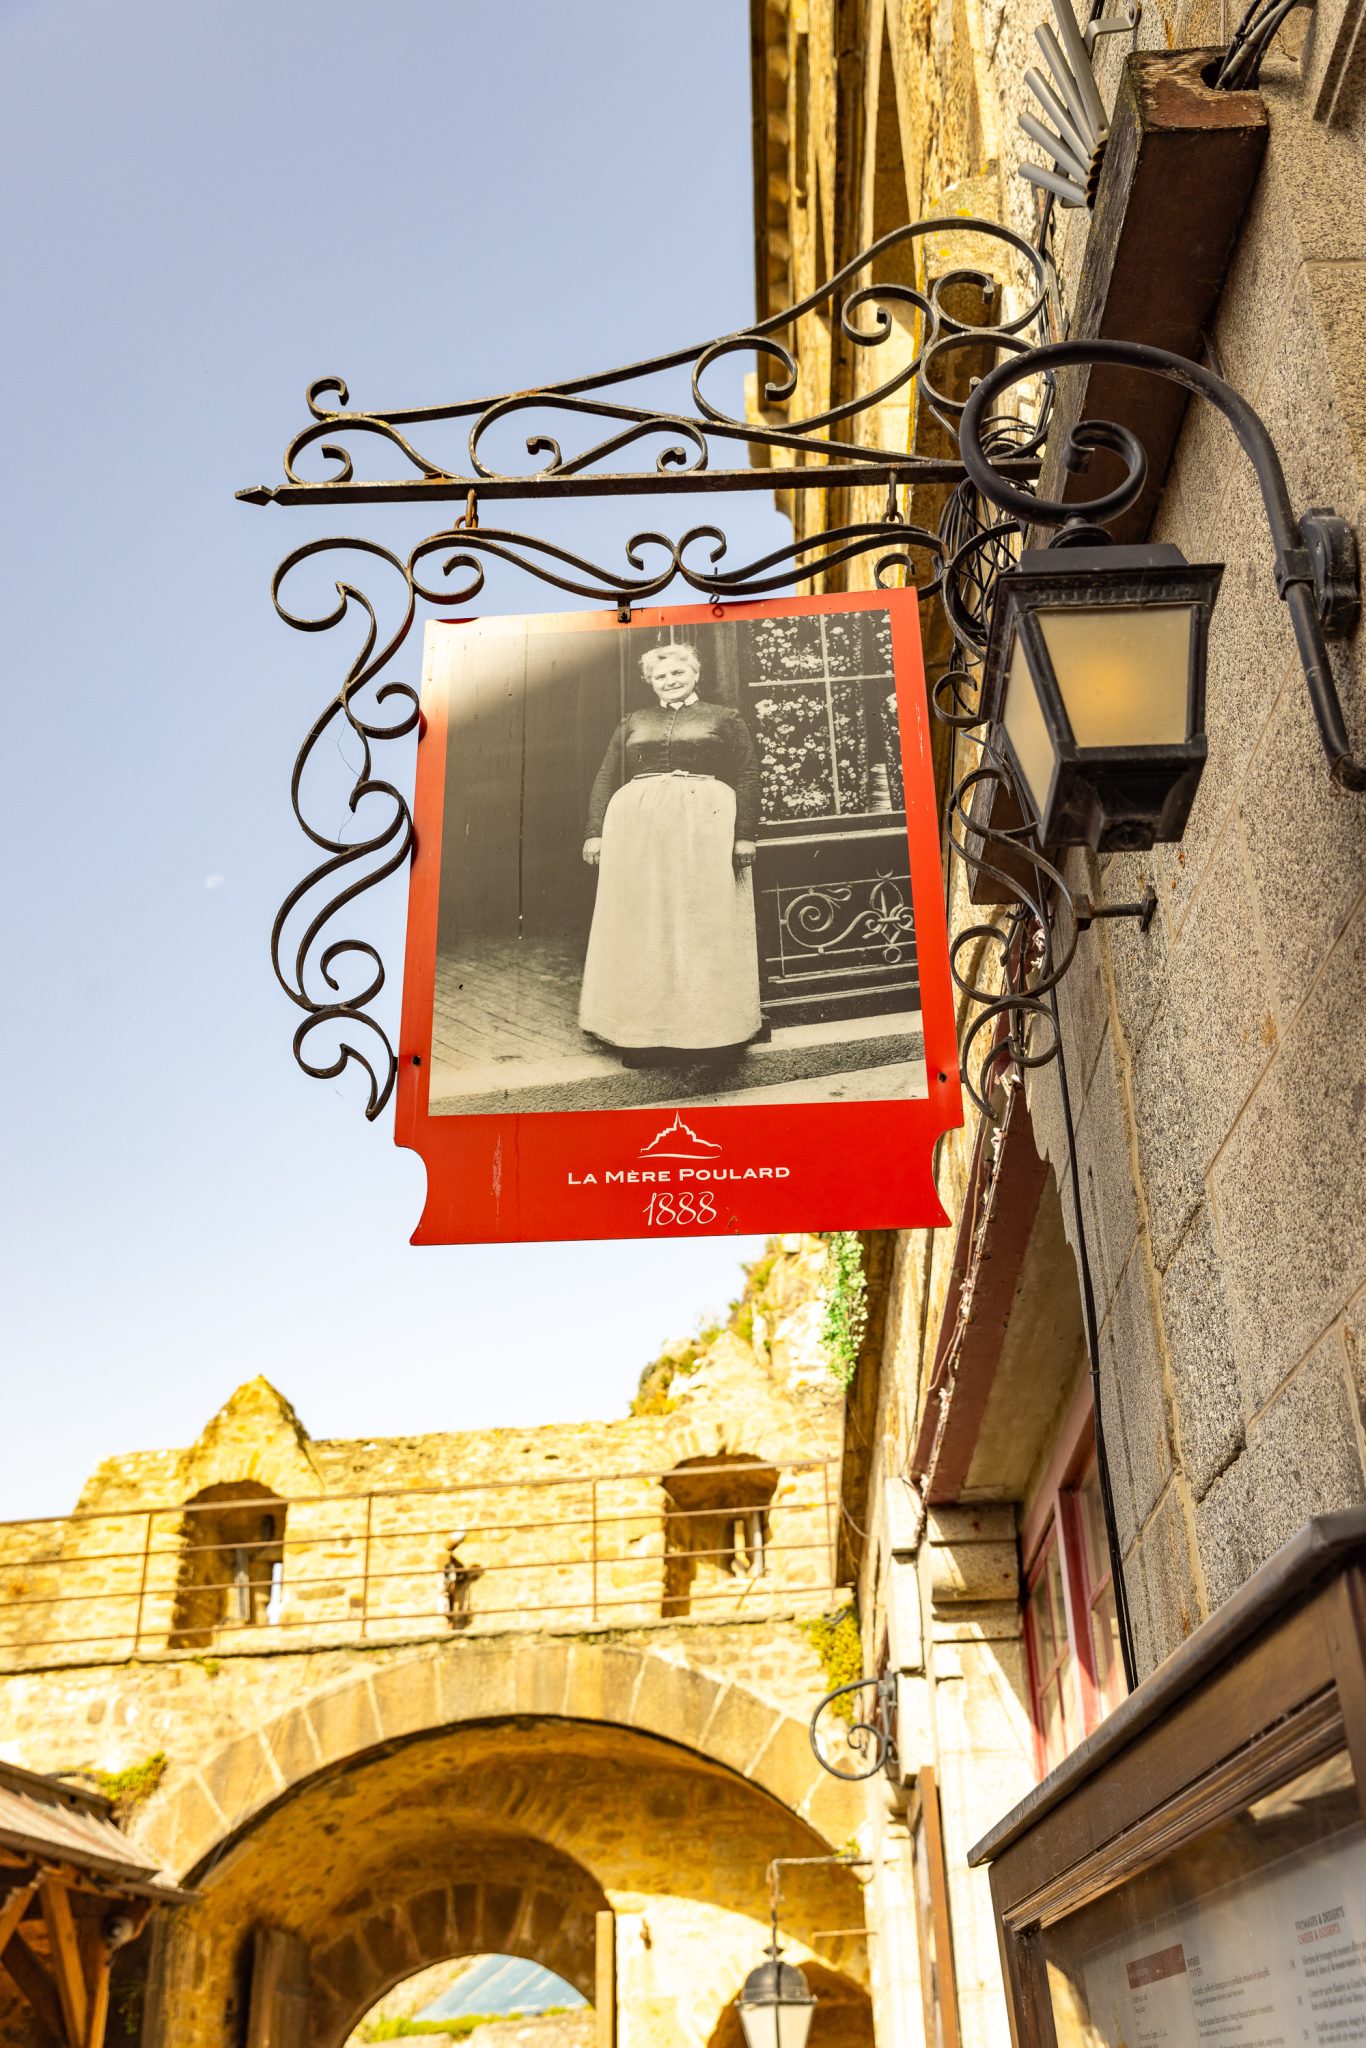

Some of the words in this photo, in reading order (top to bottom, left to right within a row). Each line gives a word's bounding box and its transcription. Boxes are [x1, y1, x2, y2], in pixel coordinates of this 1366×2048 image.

[568, 1172, 598, 1185] LA
[605, 1169, 671, 1183] MÈRE
[679, 1166, 791, 1181] POULARD
[642, 1191, 717, 1226] 1888
